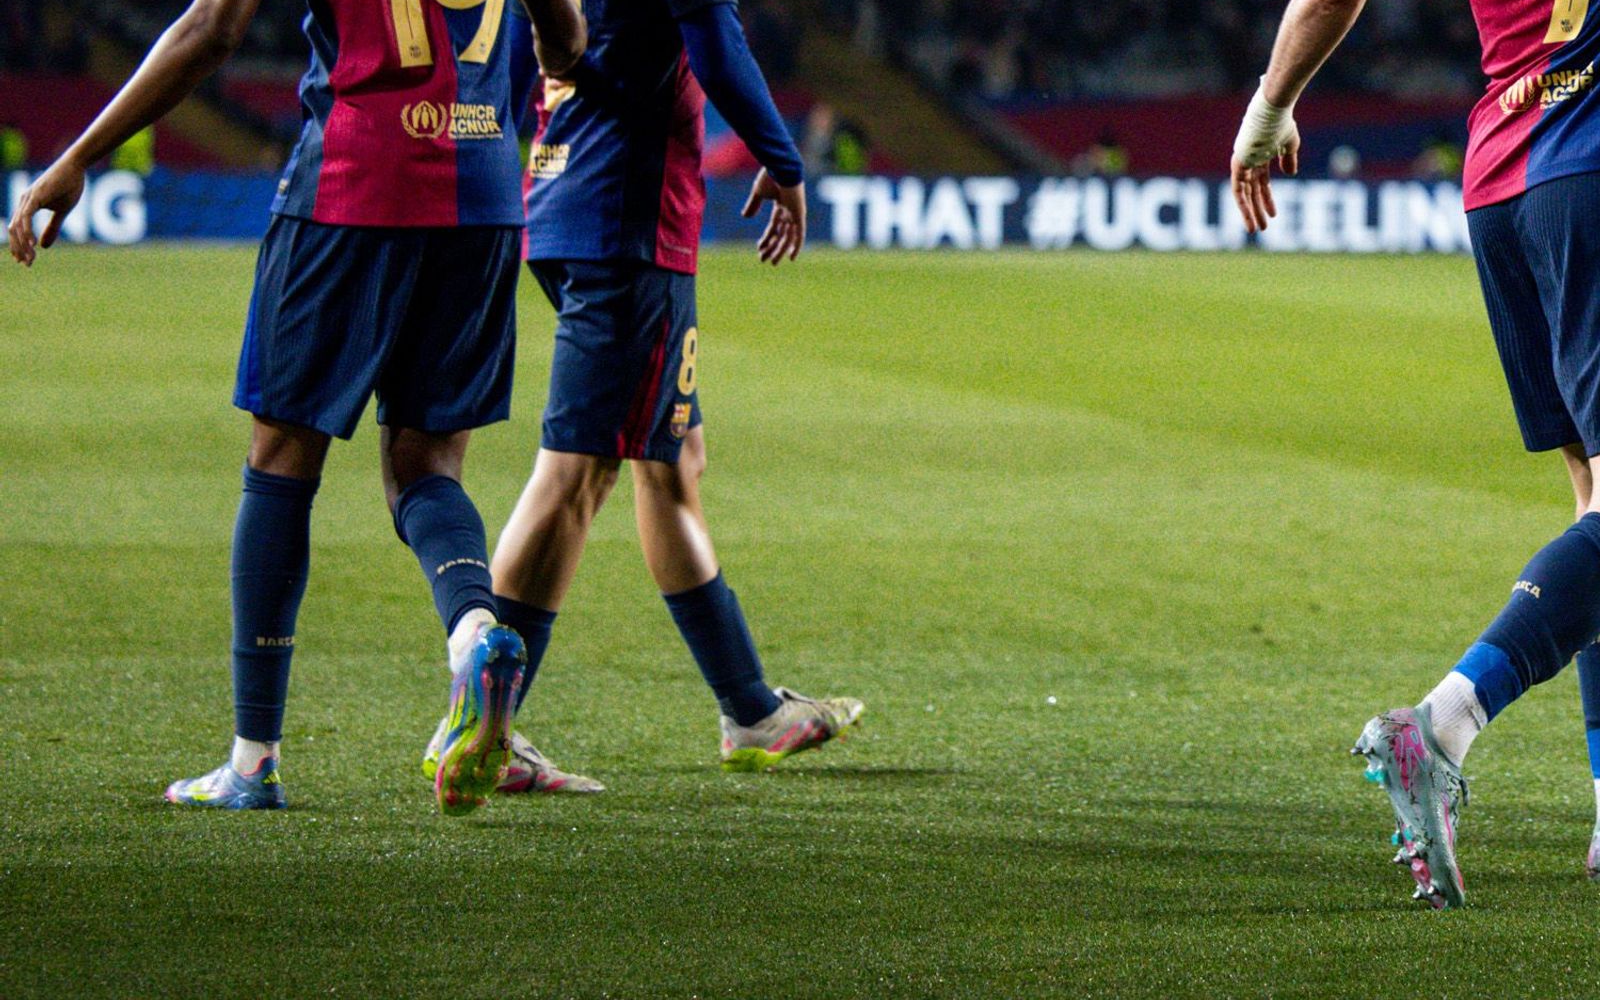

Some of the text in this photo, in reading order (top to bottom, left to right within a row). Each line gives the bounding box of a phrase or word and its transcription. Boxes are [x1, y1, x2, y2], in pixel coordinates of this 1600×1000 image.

[448, 119, 501, 134] ACNUR
[450, 103, 496, 120] UNHCR
[817, 177, 1021, 250] THAT
[678, 327, 698, 396] 8
